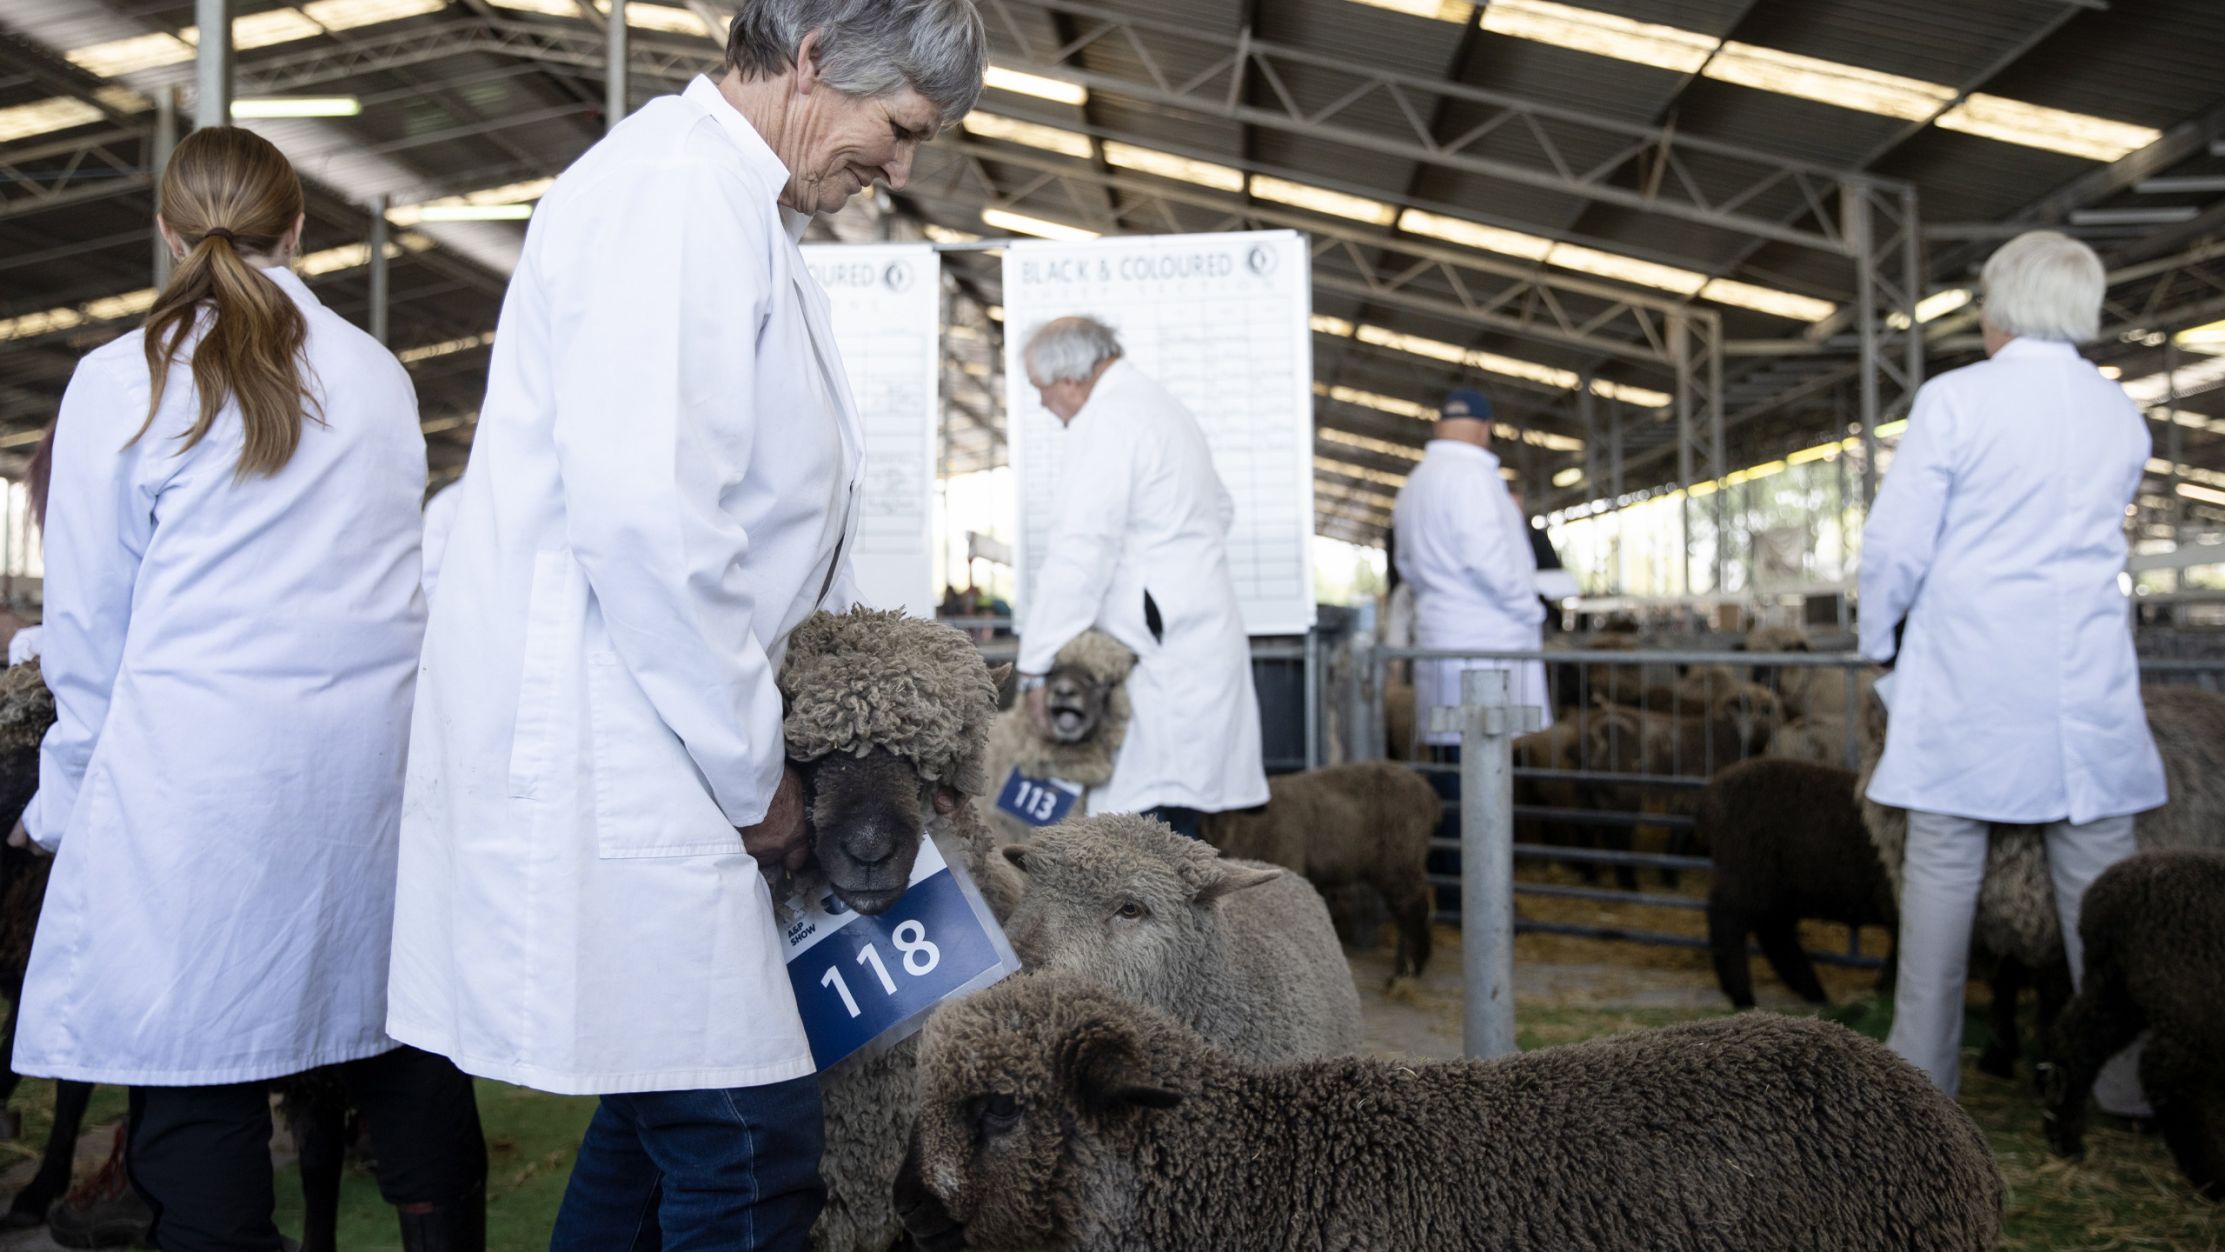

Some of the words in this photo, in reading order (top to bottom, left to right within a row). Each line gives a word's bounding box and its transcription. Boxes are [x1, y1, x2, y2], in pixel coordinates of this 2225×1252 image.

[1022, 259, 1089, 284] BLACK
[1099, 258, 1111, 282] &
[1120, 253, 1232, 281] COLOURED
[1014, 781, 1057, 821] 113
[788, 922, 804, 939] A&P
[790, 924, 816, 946] SHOW
[820, 919, 940, 1018] 118
